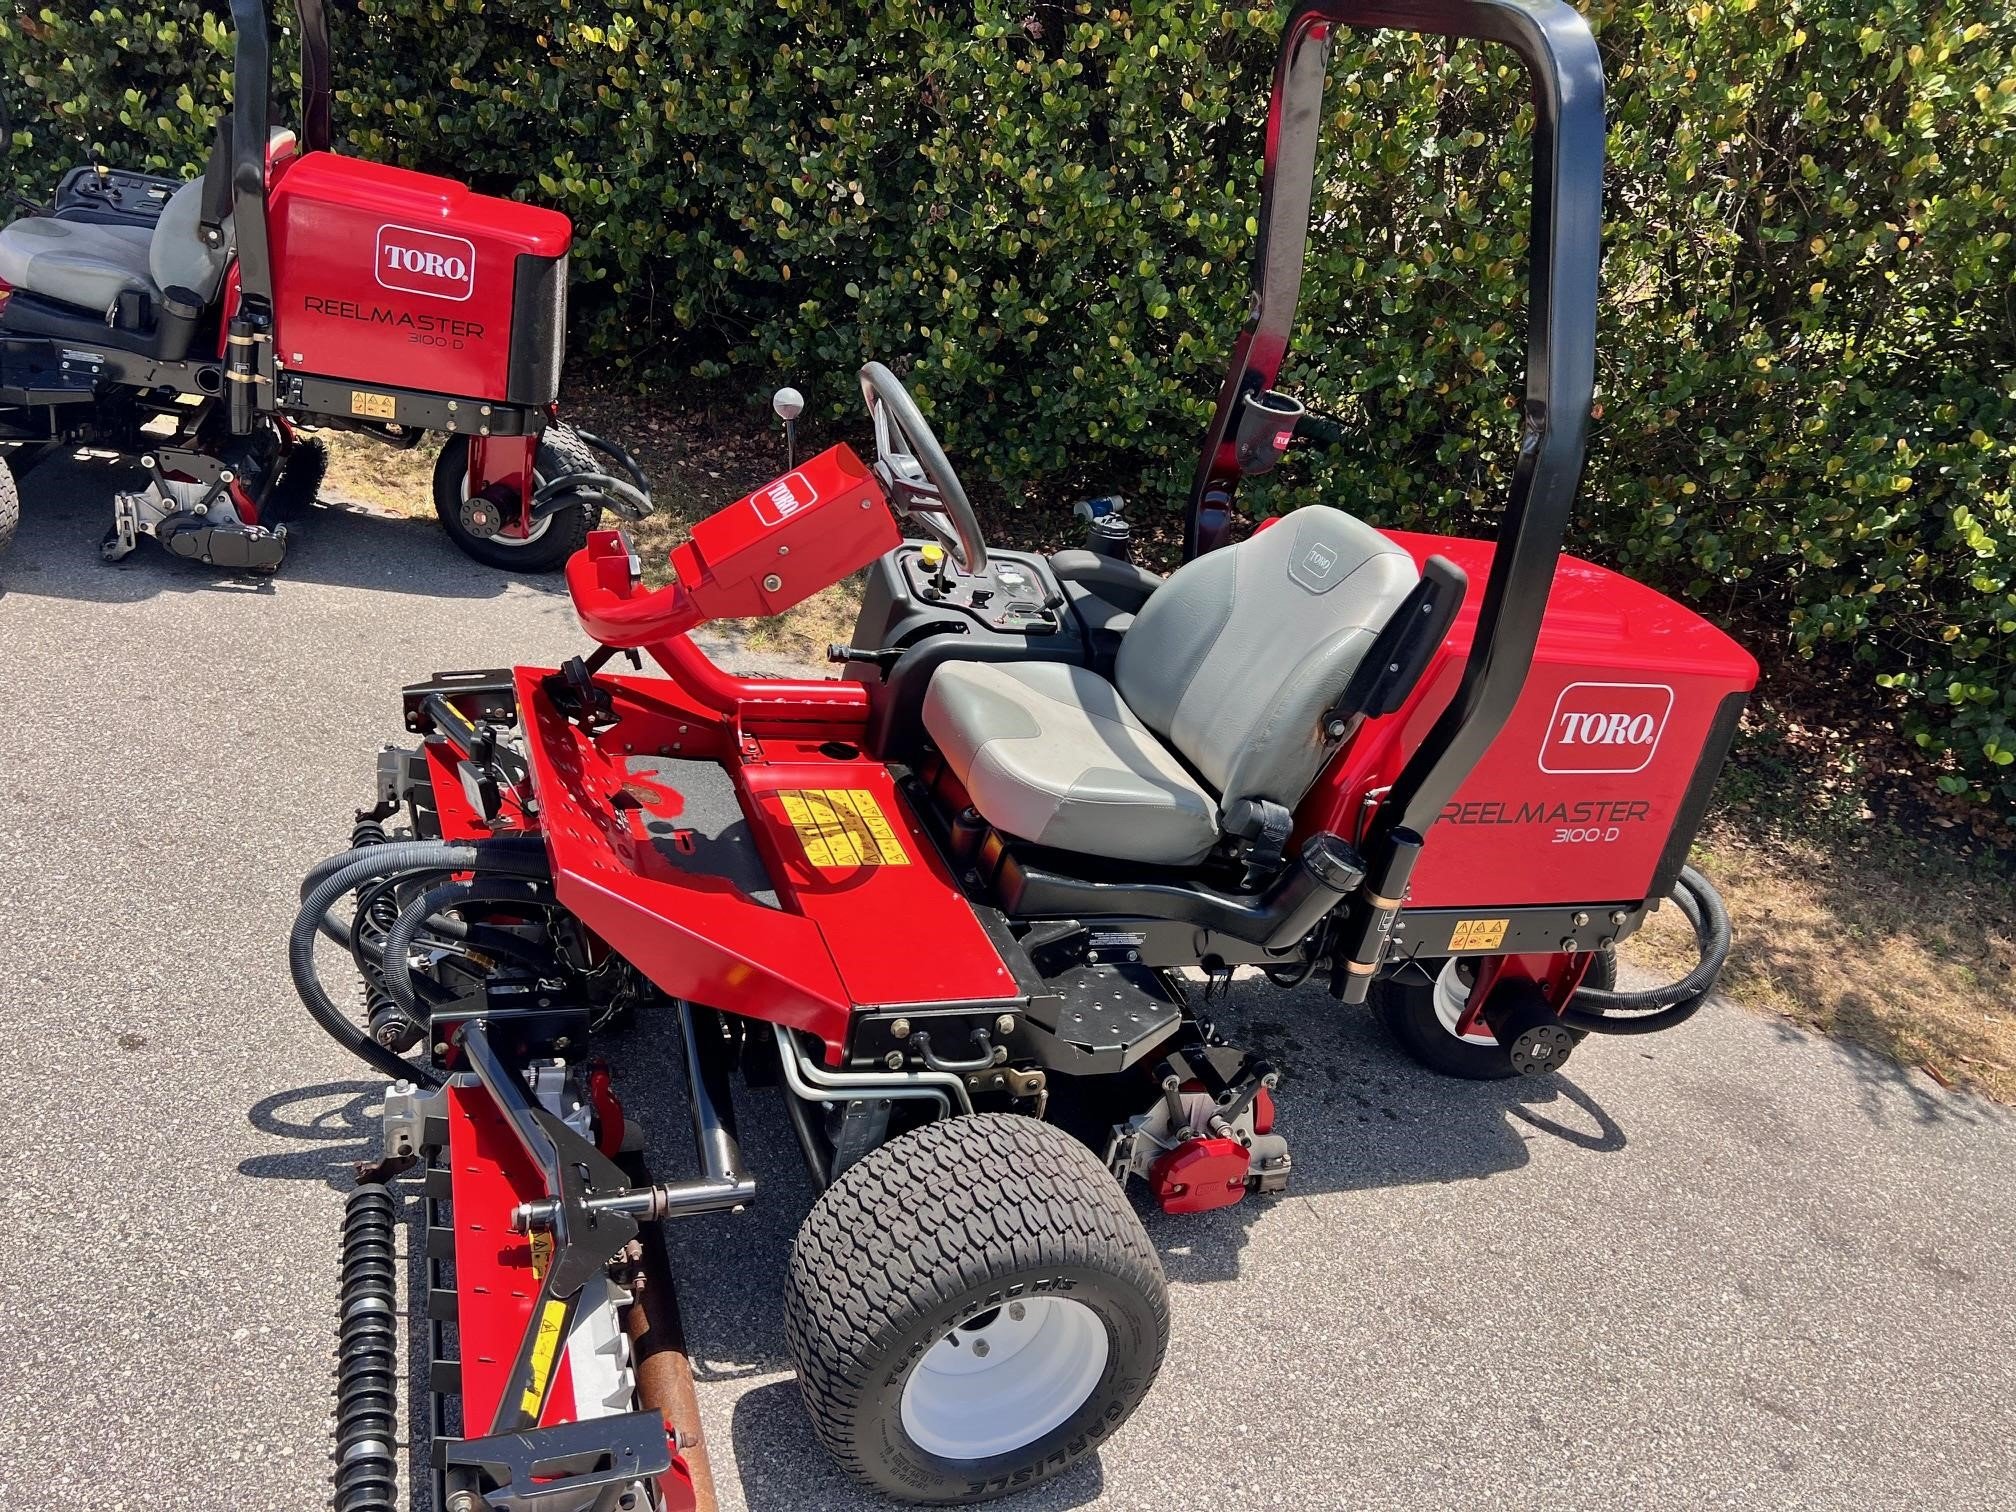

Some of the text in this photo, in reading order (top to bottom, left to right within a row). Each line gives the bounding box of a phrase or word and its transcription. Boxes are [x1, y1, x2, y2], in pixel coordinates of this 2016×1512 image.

[384, 244, 468, 281] TORO
[304, 295, 485, 340] REELMASTER
[767, 481, 799, 517] TORO
[1310, 550, 1331, 570] TORO
[1558, 712, 1654, 745] TORO
[1433, 800, 1650, 825] REELMASTER
[962, 1400, 1125, 1496] CARLISLE
